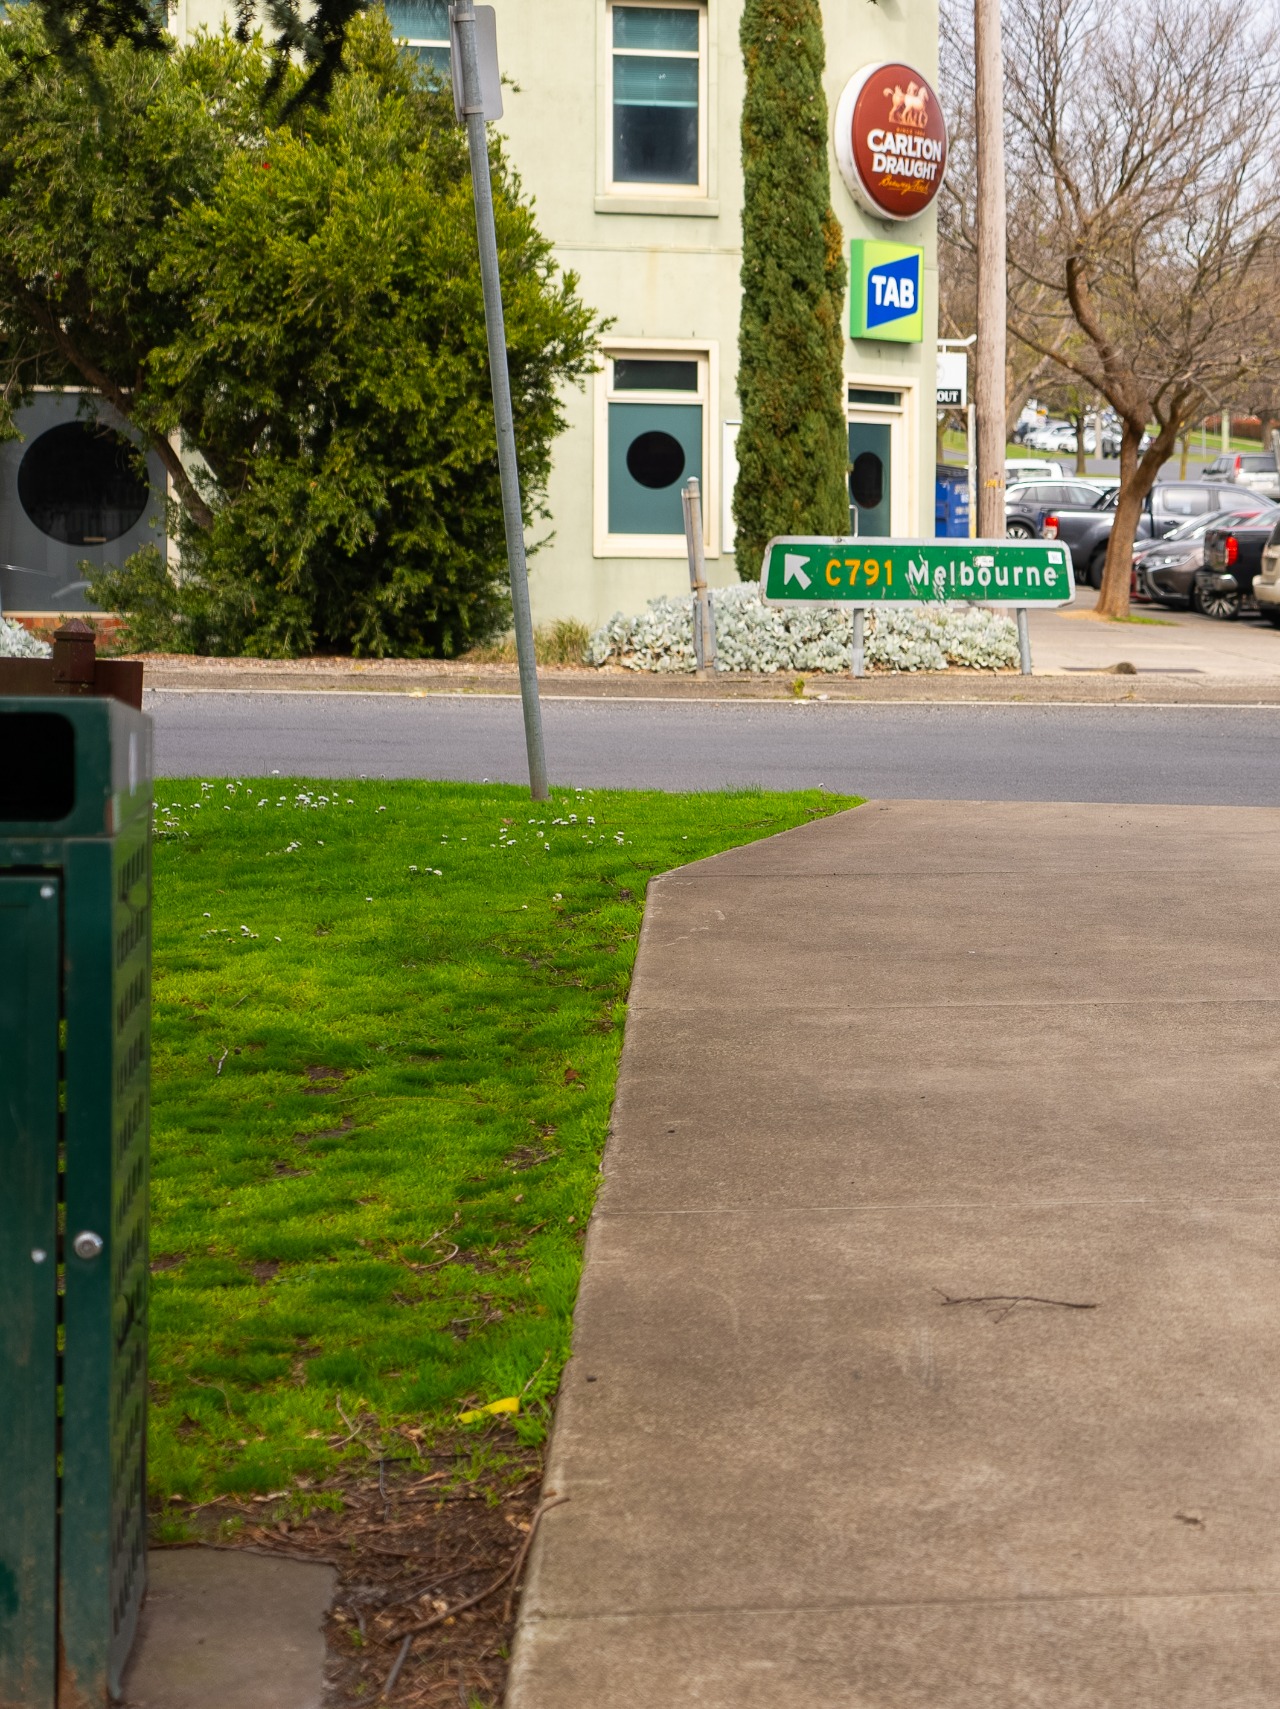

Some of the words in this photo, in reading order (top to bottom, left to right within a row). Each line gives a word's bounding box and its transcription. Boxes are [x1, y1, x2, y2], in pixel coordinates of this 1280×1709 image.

[867, 128, 942, 162] CARLTON
[872, 152, 937, 180] DRAUGHT
[871, 274, 915, 309] TAB
[936, 390, 959, 403] OUT
[825, 559, 892, 586] C791
[908, 560, 1057, 586] Melbourne
